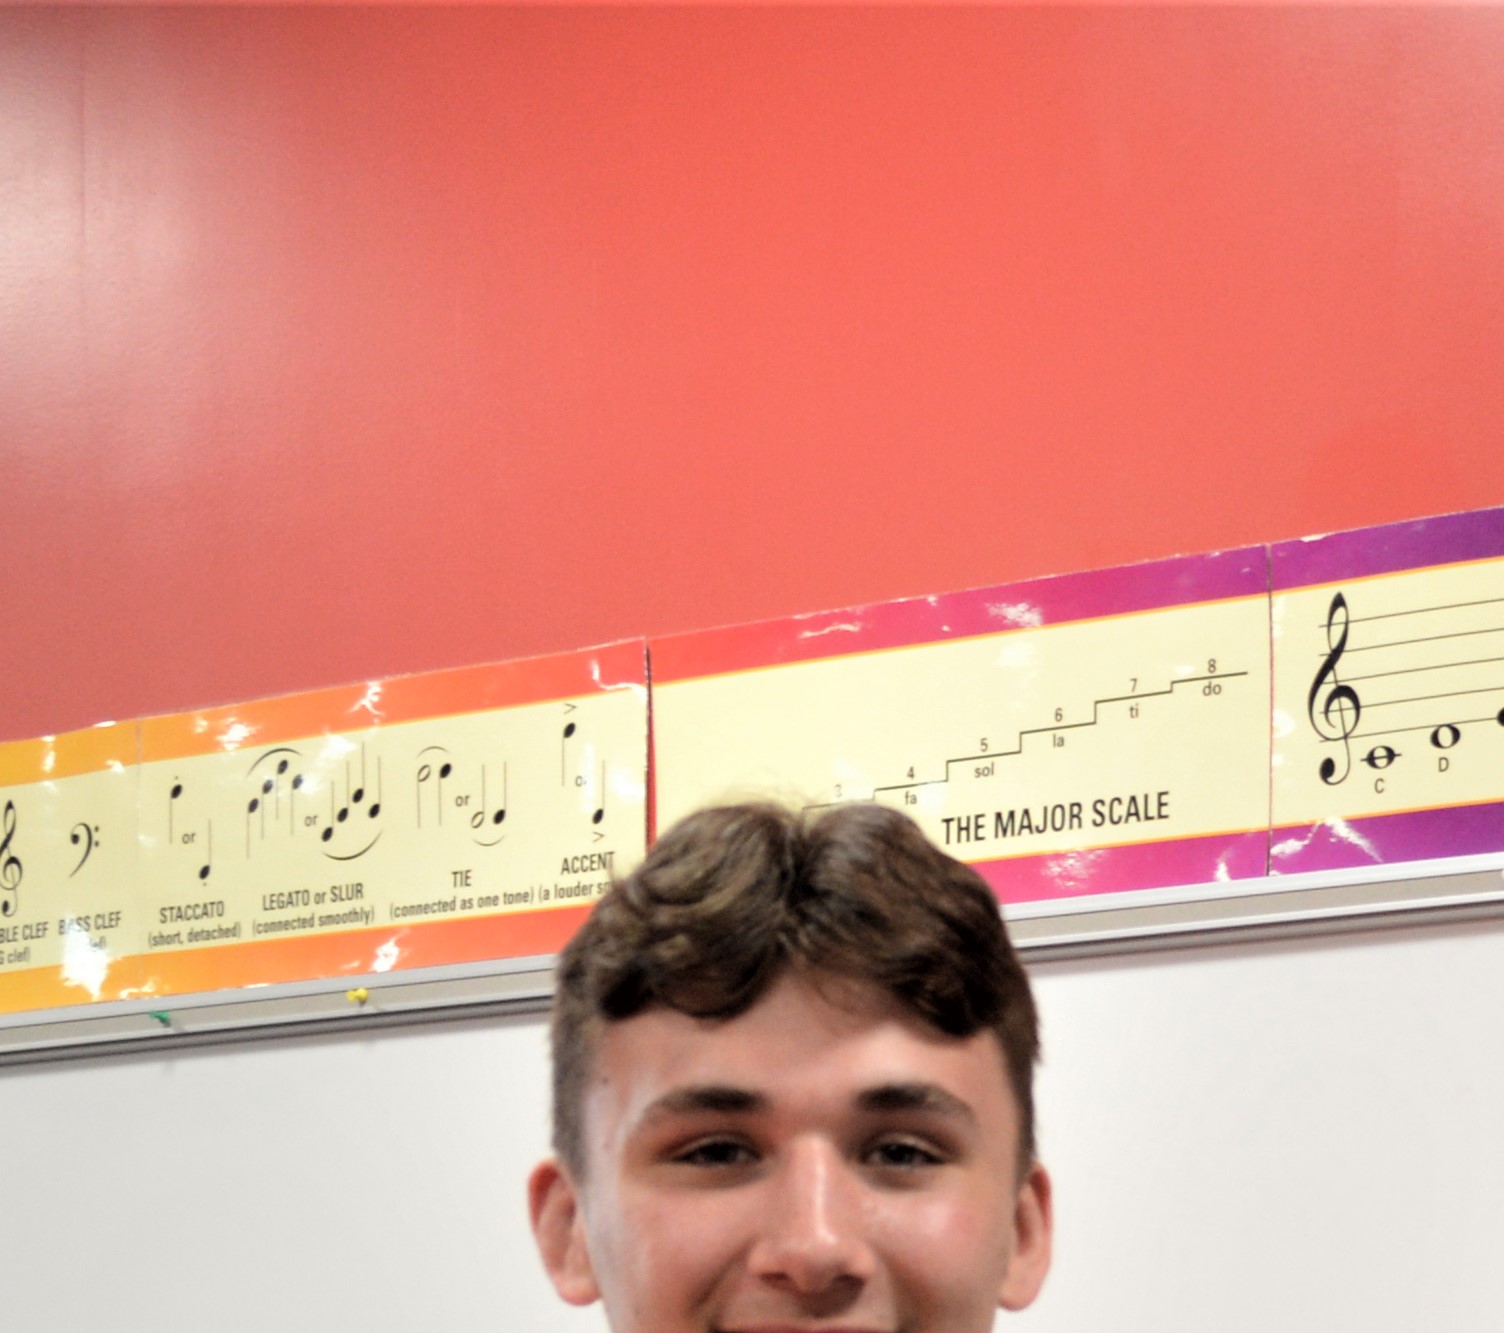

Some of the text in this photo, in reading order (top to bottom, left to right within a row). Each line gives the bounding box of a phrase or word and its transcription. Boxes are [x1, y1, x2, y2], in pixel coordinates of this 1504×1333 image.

[1207, 659, 1217, 674] 8
[1128, 678, 1138, 692] 7
[1202, 680, 1222, 696] do
[1054, 708, 1063, 722] 6
[1128, 702, 1139, 718] ti
[979, 738, 989, 752] 5
[1052, 732, 1065, 748] la
[906, 766, 916, 780] 4
[974, 761, 994, 778] sol
[1437, 756, 1450, 773] D
[1373, 777, 1386, 794] C
[904, 790, 917, 805] fa
[941, 791, 1170, 844] THE MAJOR SCALE
[560, 851, 615, 876] ACCENT
[451, 869, 473, 888] TIE
[262, 889, 311, 912] LEGATO
[330, 882, 364, 903] SLUR
[553, 880, 593, 899] louder
[389, 898, 457, 920] (connected
[476, 894, 500, 907] one
[502, 886, 535, 905] tone)
[93, 910, 122, 930] CLEF
[159, 900, 225, 925] STACCATO
[252, 905, 375, 936] (connected smoothly)
[21, 921, 49, 940] CLEF
